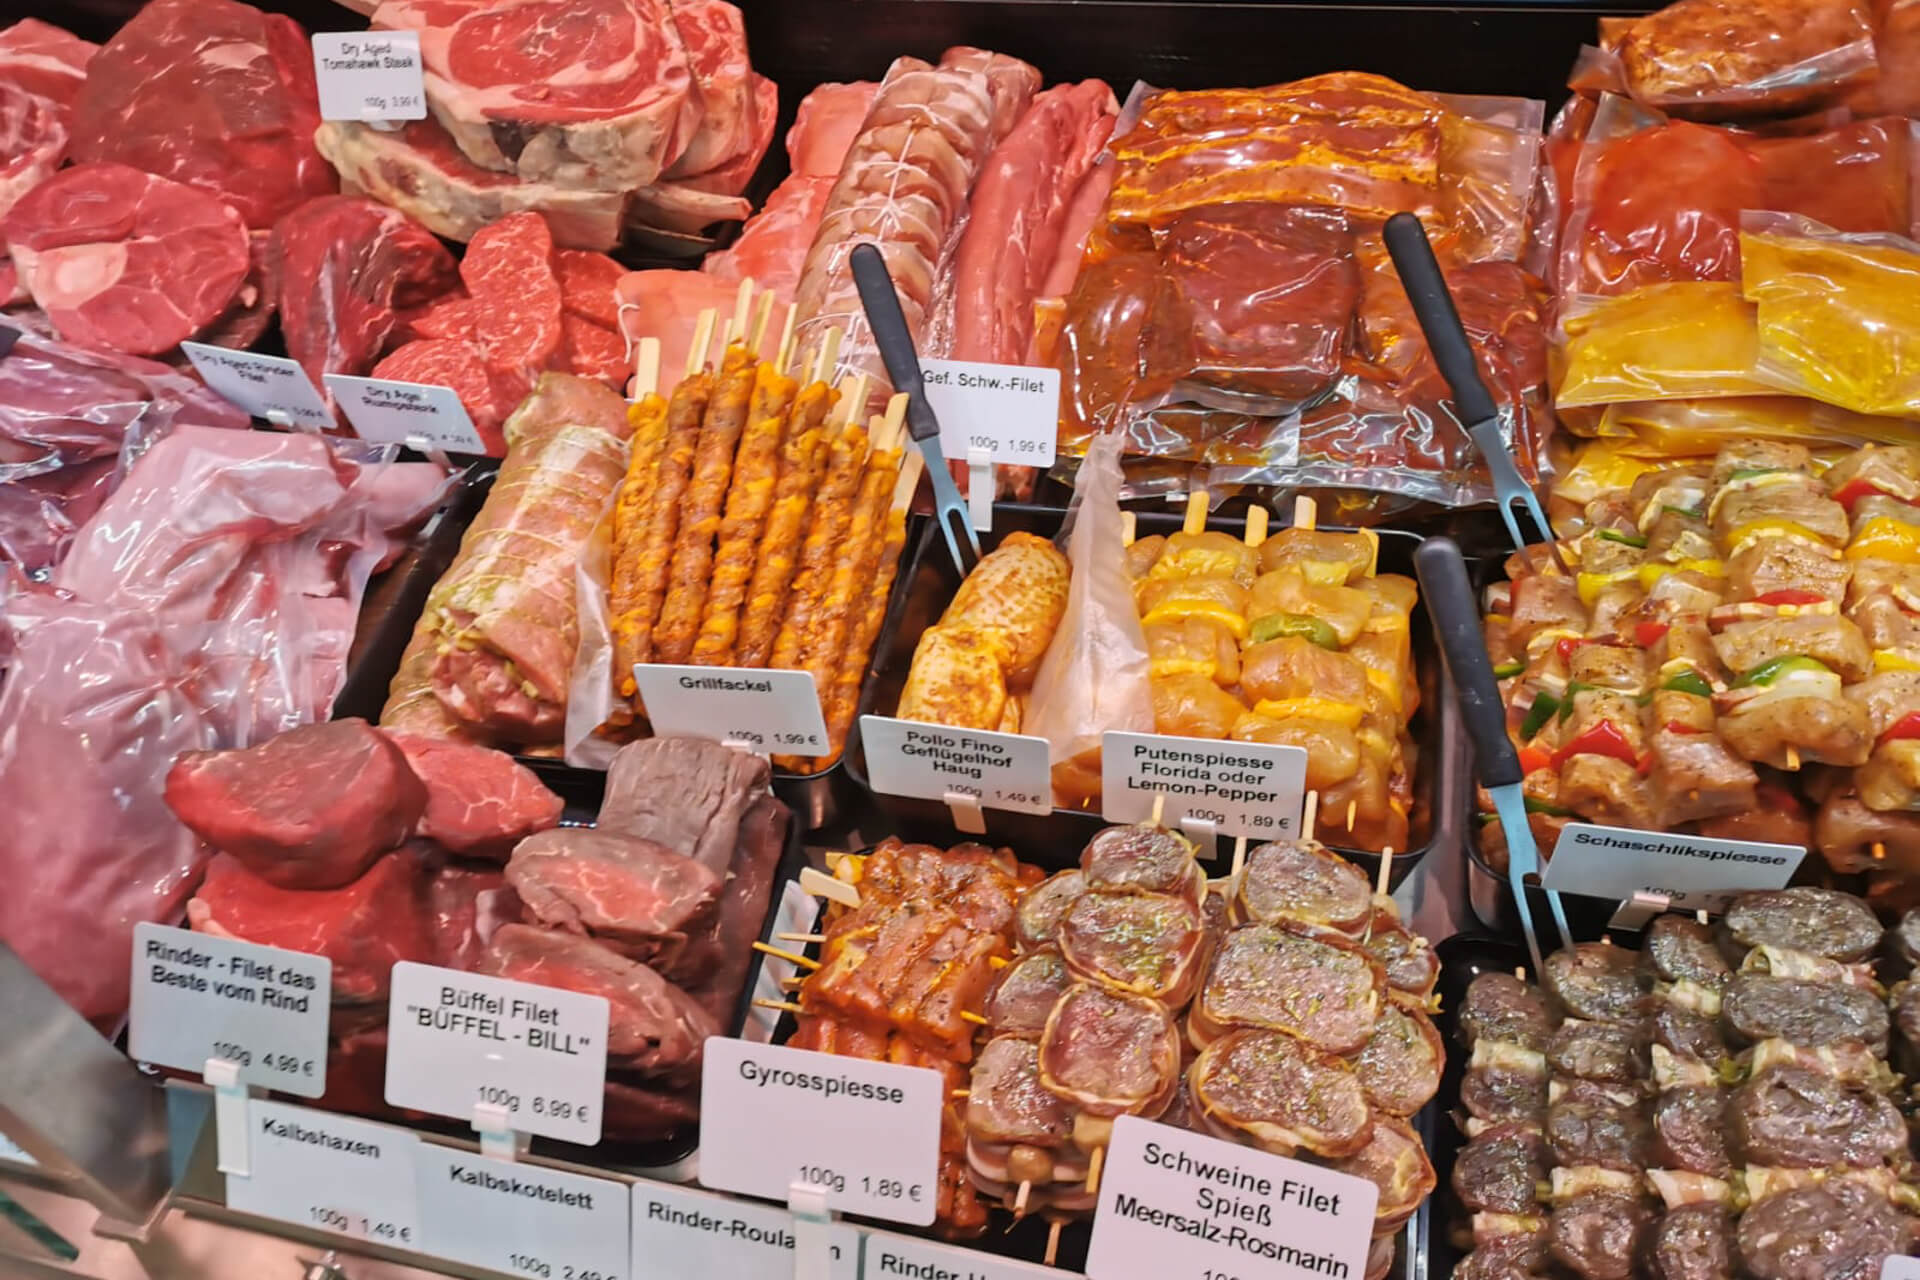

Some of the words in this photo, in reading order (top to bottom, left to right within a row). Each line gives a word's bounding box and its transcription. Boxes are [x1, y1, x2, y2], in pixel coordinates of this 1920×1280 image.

[322, 58, 380, 70] Tomahawk
[384, 57, 413, 68] Steak
[341, 42, 359, 57] Dry
[363, 42, 392, 57] Aged
[922, 370, 953, 386] Gef.
[958, 373, 1045, 393] Schw.-Filet
[970, 435, 998, 452] 100g
[1039, 442, 1047, 454] €
[679, 676, 772, 692] Grillfackel
[728, 730, 763, 745] 100g
[808, 735, 818, 745] €
[907, 731, 955, 748] Pollo
[961, 738, 1004, 754] Fino
[901, 743, 1013, 768] Geflügelhof
[933, 761, 982, 779] Haug
[1134, 745, 1274, 770] Putenspiesse
[1128, 776, 1278, 803] Lemon-Pepper
[1141, 762, 1211, 781] Florida
[1218, 770, 1266, 786] oder
[947, 783, 983, 798] 100g
[1031, 794, 1041, 805] €
[1187, 808, 1225, 825] 100g
[1278, 818, 1290, 829] €
[1574, 833, 1788, 866] Schaschlikspiesse
[145, 939, 213, 969] Rinder
[230, 957, 274, 983] Filet
[279, 968, 316, 990] das
[151, 964, 208, 992] Beste
[213, 980, 256, 1003] vom
[261, 987, 309, 1013] Rind
[441, 986, 505, 1016] Büffel
[511, 1000, 560, 1026] Filet
[407, 1004, 507, 1041] "BÜFFEL
[528, 1028, 590, 1055] BILL"
[213, 1042, 251, 1067] 100g
[302, 1060, 314, 1077] €
[739, 1060, 904, 1104] Gyrosspiesse
[478, 1085, 520, 1112] 100g
[577, 1105, 589, 1123] €
[262, 1117, 381, 1158] Kalbshaxen
[449, 1164, 594, 1211] Kalbskotelett
[800, 1165, 845, 1193] 100g
[909, 1184, 922, 1202] €
[1143, 1142, 1272, 1196] Schweine
[1280, 1180, 1341, 1216] Filet
[1197, 1187, 1272, 1227] Spieß
[310, 1206, 349, 1231] 100g
[400, 1227, 411, 1242] €
[648, 1201, 841, 1260] Rinder-Roulan
[1114, 1193, 1349, 1279] Meersalz-Rosmarin
[510, 1253, 551, 1279] 100g
